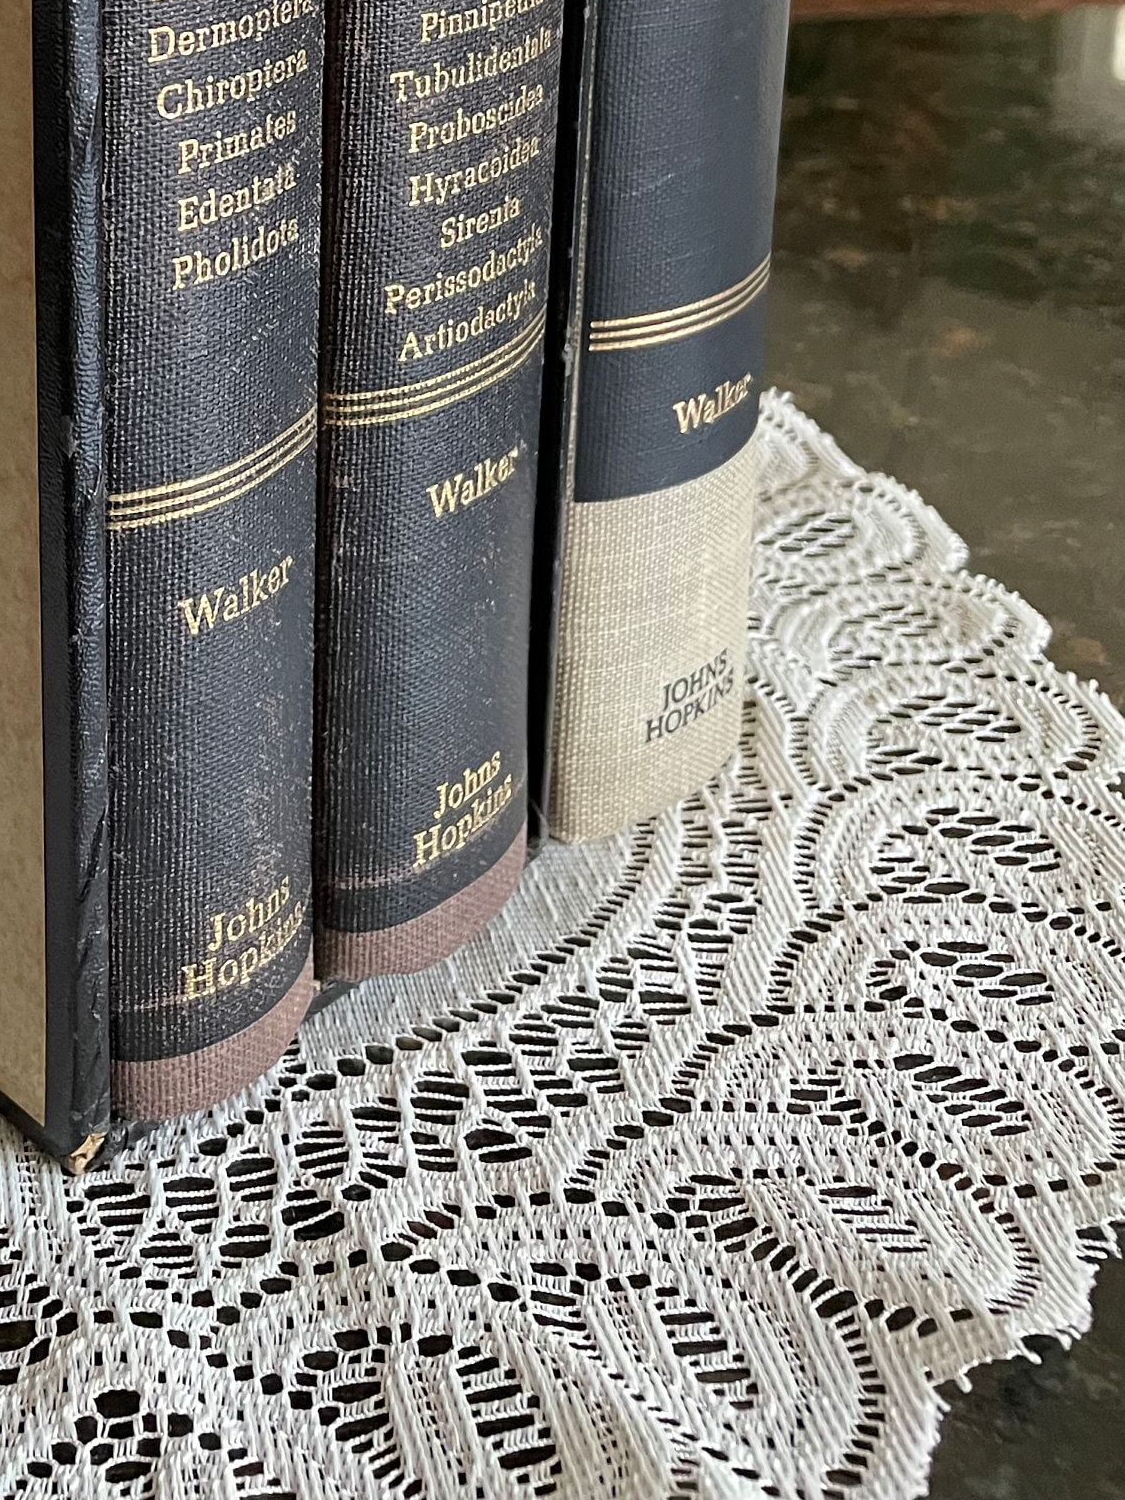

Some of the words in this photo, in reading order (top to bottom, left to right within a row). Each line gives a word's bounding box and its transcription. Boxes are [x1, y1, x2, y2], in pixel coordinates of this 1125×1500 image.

[157, 47, 307, 120] Chiroptera
[390, 26, 552, 104] Tubulidentata
[178, 109, 296, 174] Primates
[408, 82, 543, 154] Proboscidea
[177, 162, 297, 231] Edentata
[408, 134, 540, 207] Hyracoidea
[172, 216, 299, 290] Pholidota
[440, 195, 521, 249] Sirenia
[673, 373, 752, 434] Walker
[426, 446, 519, 518] Walker
[178, 555, 294, 636] Walker
[645, 666, 735, 743] HOPKINS
[663, 648, 729, 711] JOHNS
[412, 773, 512, 868] Hopkins
[433, 750, 502, 821] Johns
[208, 875, 289, 951] Johns
[181, 901, 303, 1000] Hopkins
